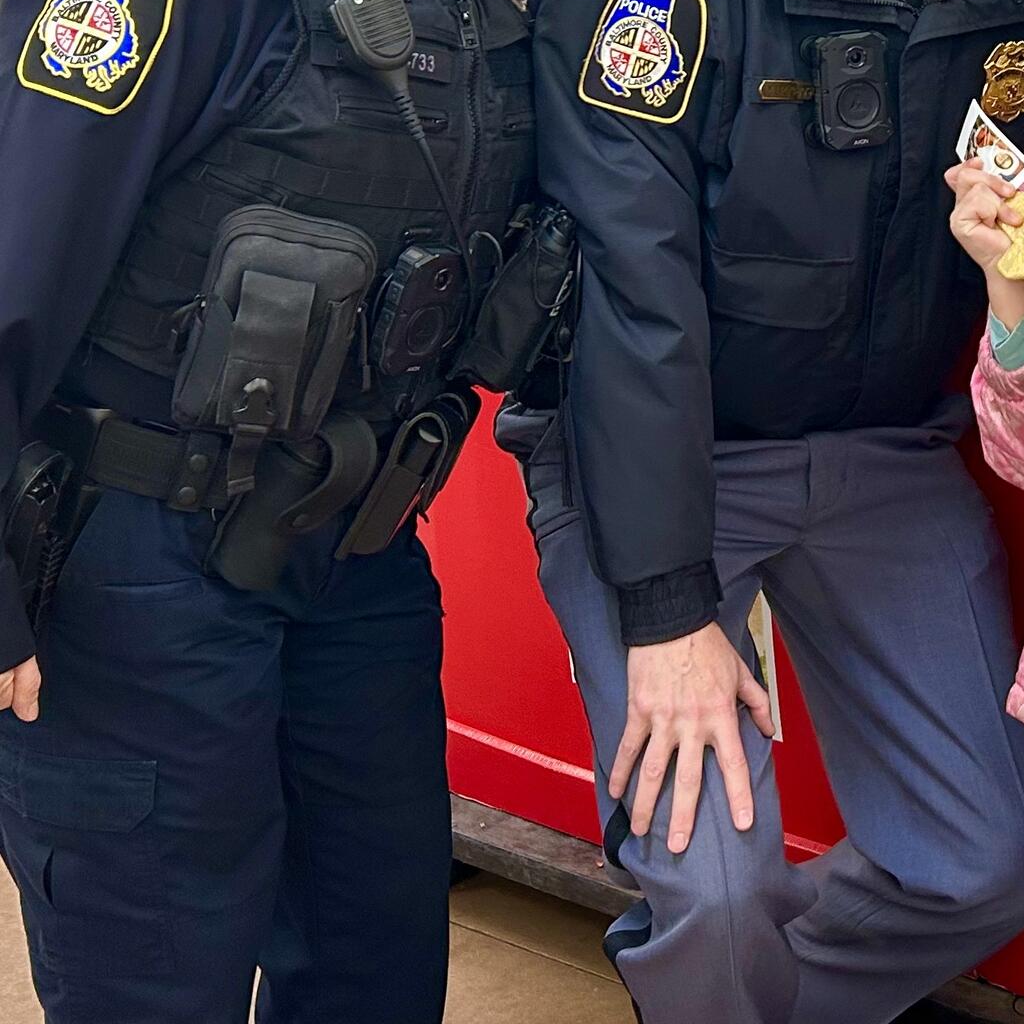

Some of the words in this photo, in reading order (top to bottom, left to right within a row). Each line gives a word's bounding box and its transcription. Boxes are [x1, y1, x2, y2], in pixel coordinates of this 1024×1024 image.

[105, 0, 122, 41] COUNTY
[50, 41, 98, 64] MARYLAND
[606, 19, 648, 46] BALTIMORE
[651, 27, 667, 64] COUNTY
[408, 53, 435, 72] 733
[607, 63, 652, 85] MARYLAND
